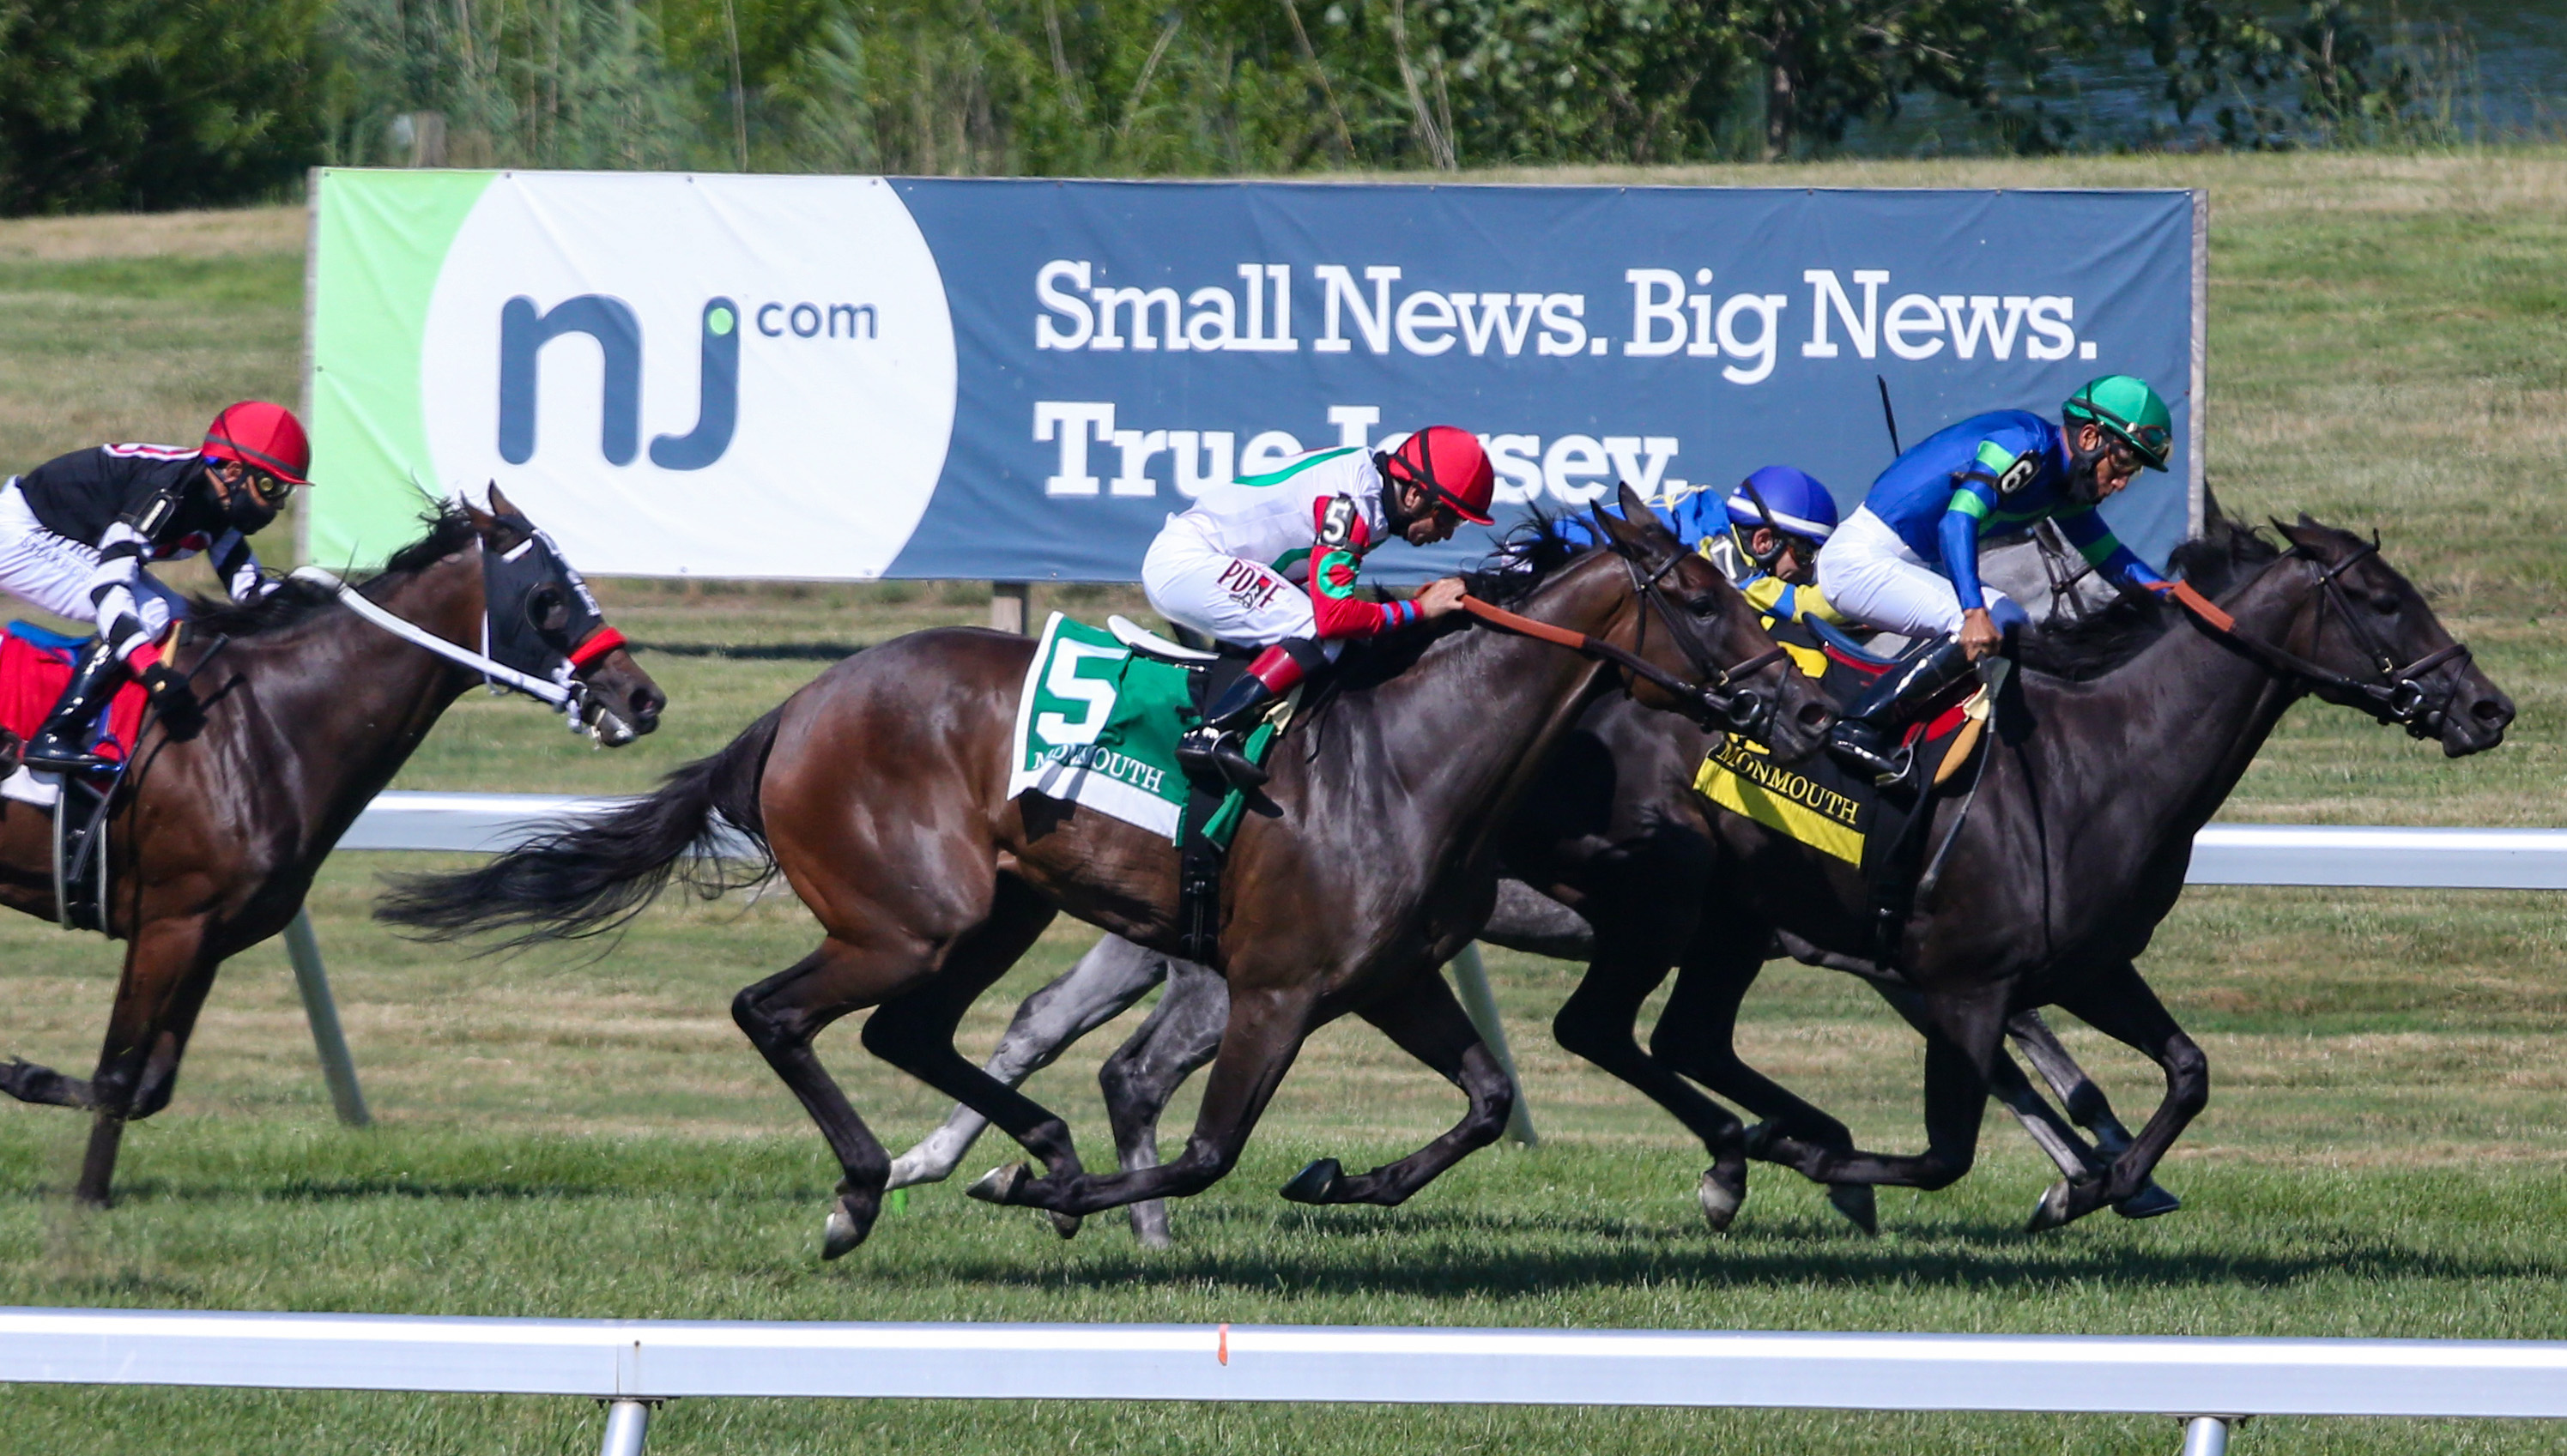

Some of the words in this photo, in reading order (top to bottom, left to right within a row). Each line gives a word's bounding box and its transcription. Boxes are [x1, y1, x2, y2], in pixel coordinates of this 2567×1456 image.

[756, 301, 878, 340] com
[1034, 259, 1299, 352] Small
[1314, 264, 1608, 357] News.
[1624, 267, 1788, 385] Big
[1802, 269, 2098, 360] News.
[1032, 401, 1305, 499] True
[1328, 405, 1688, 505] sey.
[2001, 460, 2033, 493] 6
[1323, 500, 1352, 542] 5
[1710, 536, 1738, 580] 7
[1036, 637, 1129, 746] 5
[1716, 740, 1861, 825] MONMOUTH
